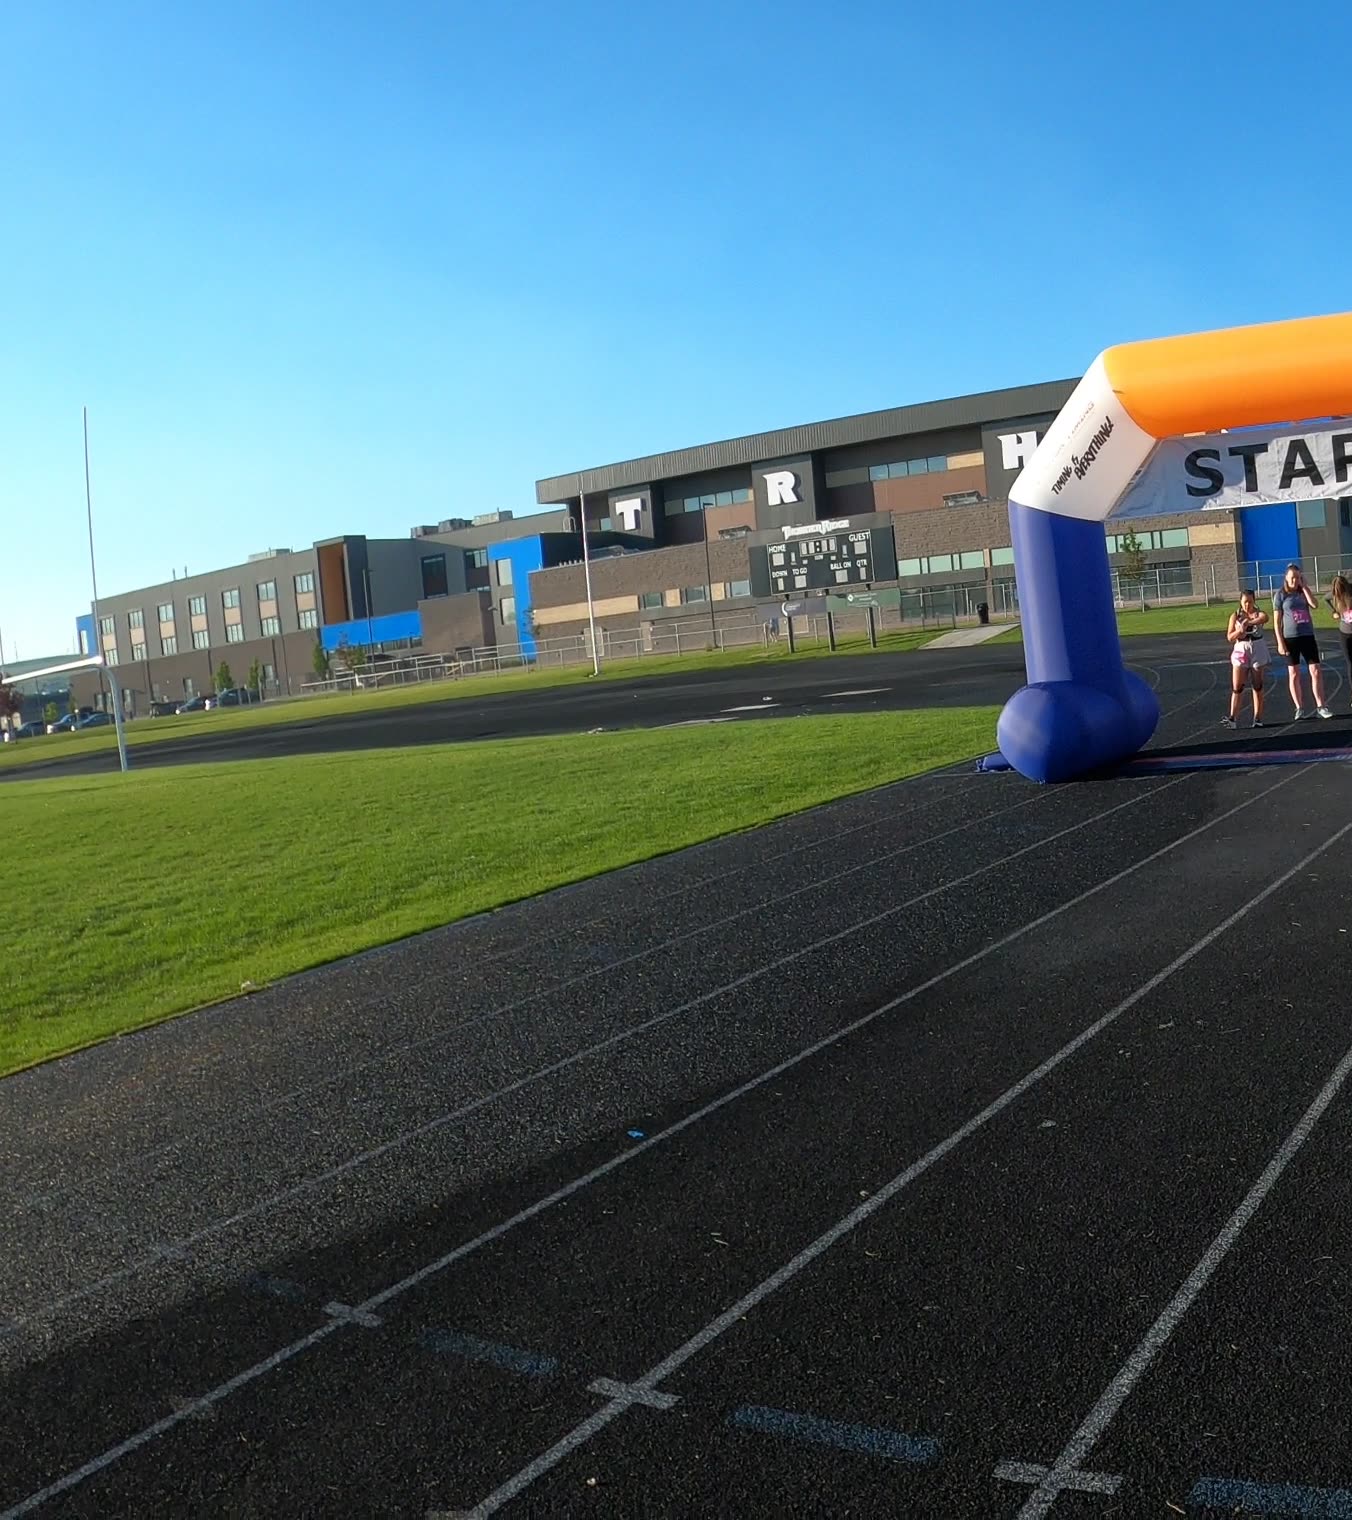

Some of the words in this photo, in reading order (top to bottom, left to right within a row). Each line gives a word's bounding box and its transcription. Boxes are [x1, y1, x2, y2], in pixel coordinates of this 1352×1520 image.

[615, 498, 642, 531] T
[762, 470, 798, 506] R
[997, 431, 1038, 470] H
[1051, 465, 1072, 495] TIMING
[848, 532, 870, 541] GUEST
[768, 543, 786, 553] HOME
[830, 562, 842, 570] BALL
[843, 560, 851, 568] ON
[856, 559, 867, 567] QTR
[772, 569, 788, 579] DOWN
